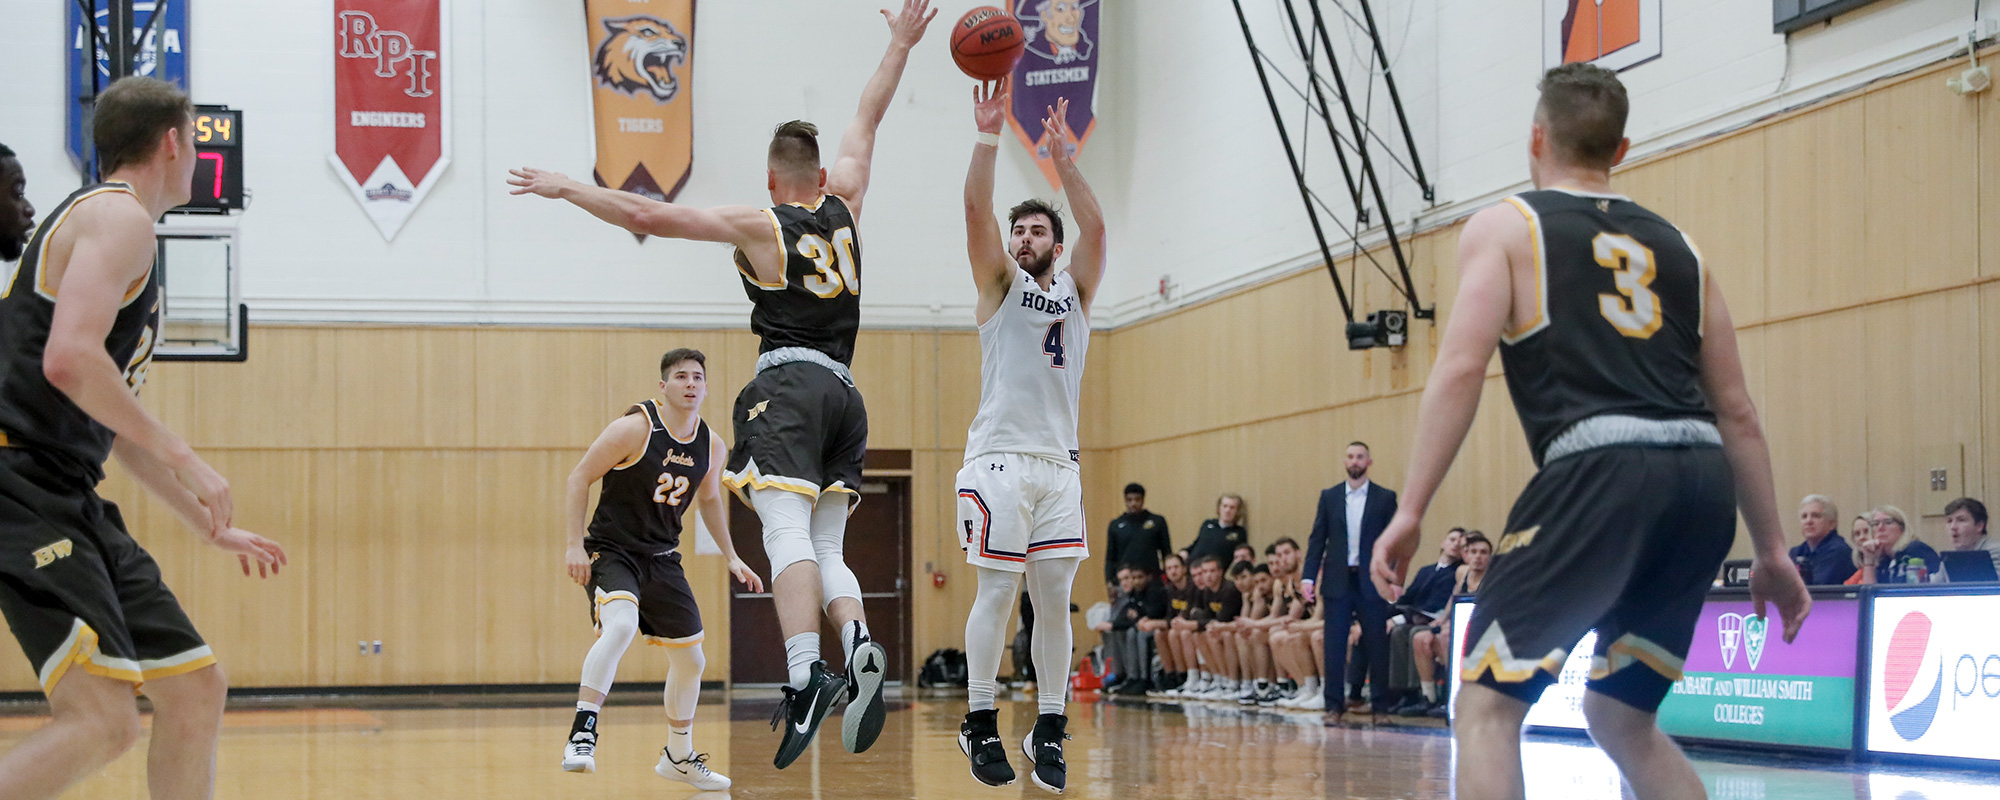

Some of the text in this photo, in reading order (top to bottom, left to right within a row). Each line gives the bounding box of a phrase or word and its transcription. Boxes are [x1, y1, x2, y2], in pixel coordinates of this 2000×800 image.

[981, 26, 1015, 45] NCAA
[339, 10, 436, 97] RPI
[1025, 66, 1089, 86] STATESMEN
[351, 110, 426, 128] ENGINEERS
[618, 117, 664, 133] TIGERS
[796, 226, 859, 298] 30
[1592, 232, 1663, 340] 3
[1042, 319, 1066, 369] 4
[653, 472, 690, 506] 22
[32, 539, 73, 569] BW
[1672, 676, 1813, 700] HOBART AND WILLIAM SMITH
[1714, 703, 1765, 725] COLLEGES
